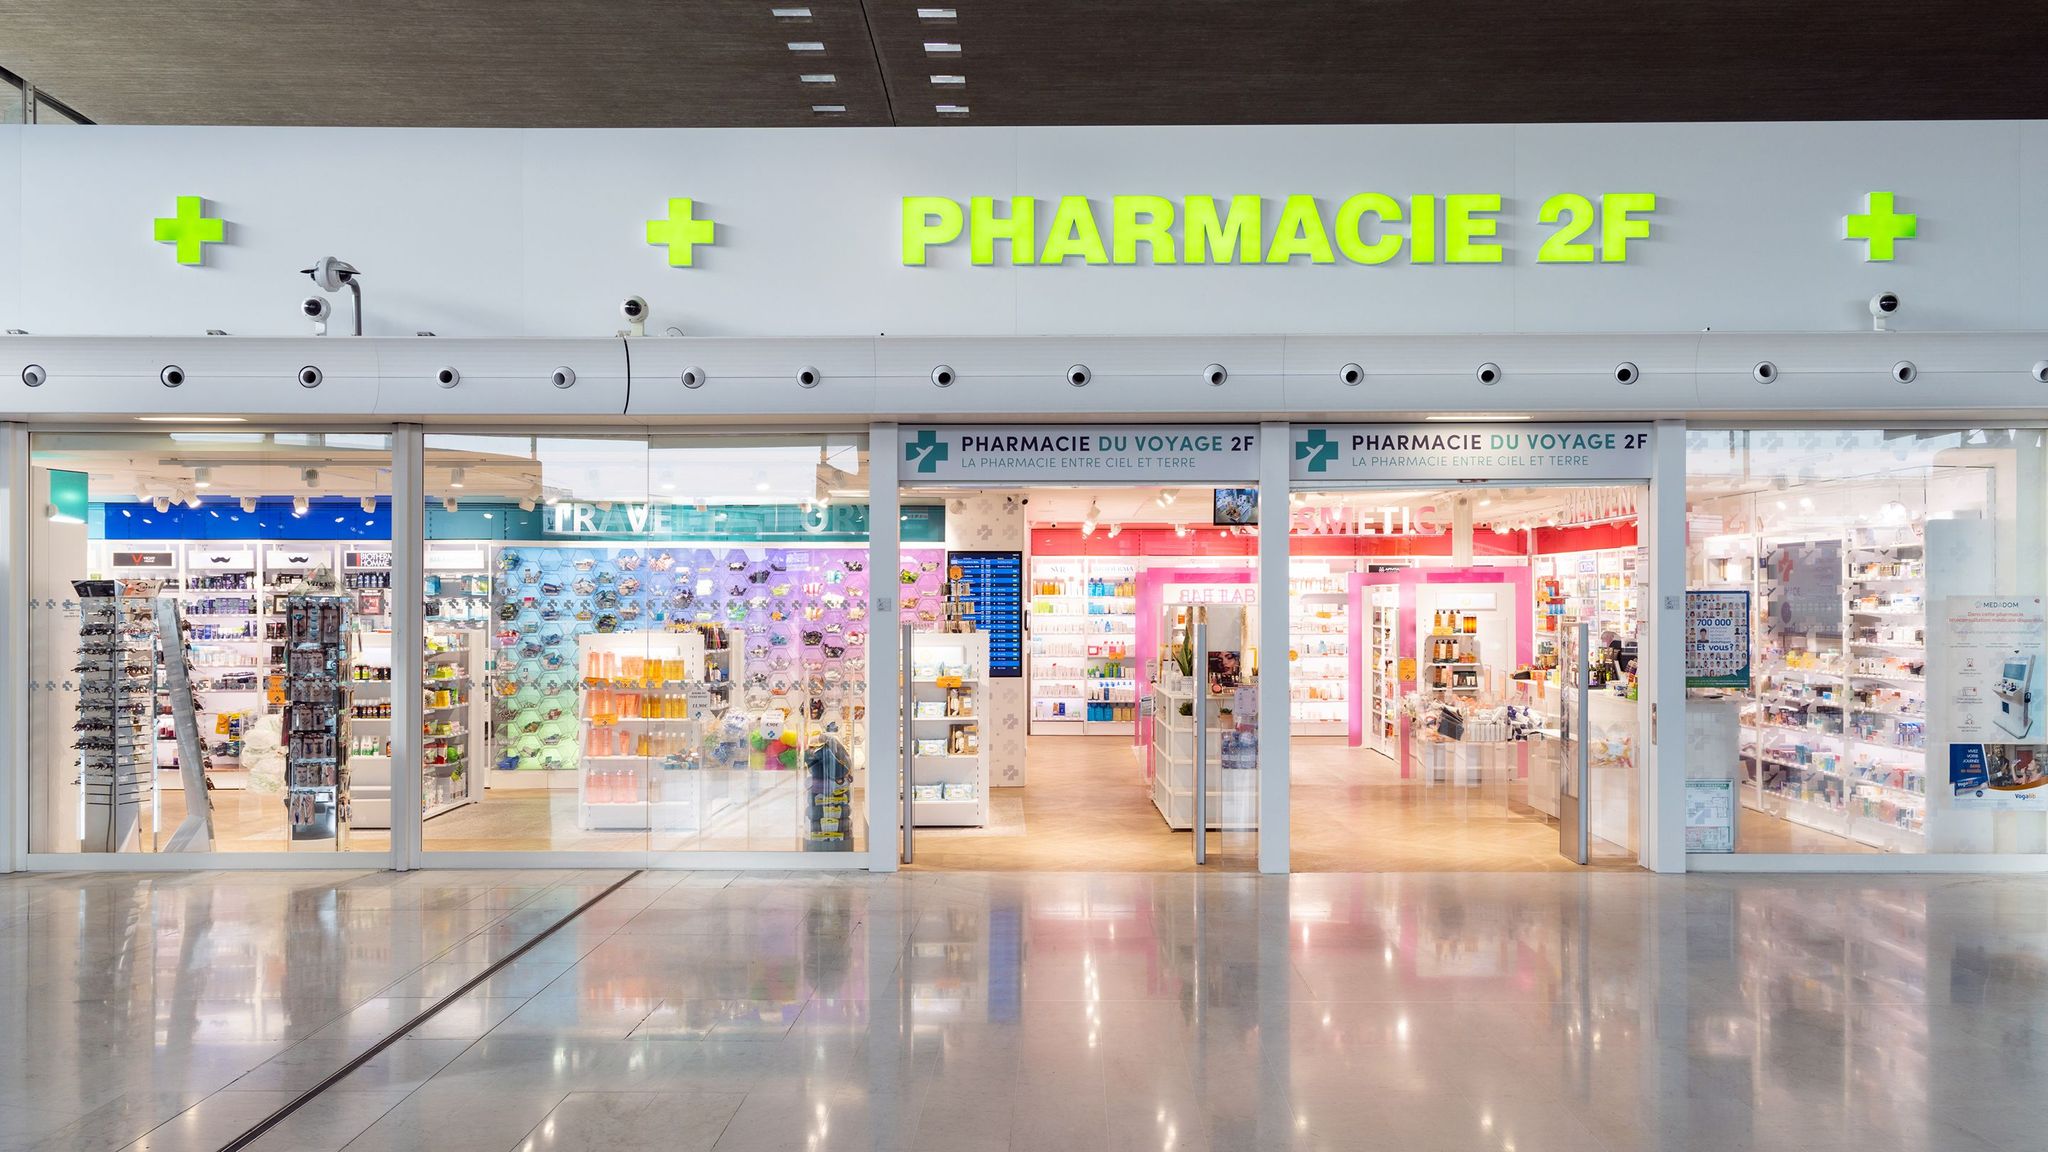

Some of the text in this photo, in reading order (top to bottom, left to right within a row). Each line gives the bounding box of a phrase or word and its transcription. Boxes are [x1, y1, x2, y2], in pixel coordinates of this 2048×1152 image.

[902, 193, 1656, 265] PHARMACIE 2F
[962, 436, 1255, 452] PHARMACIE DU VOYAGE 2F
[1352, 433, 1648, 451] PHARMACIE DU VOYAGE 2F
[961, 457, 1196, 468] LA PHARMACIE ENTRE CIEL ET TERRE
[1352, 455, 1589, 467] LA PHARMACIE ENTRE CIEL ET TERRE
[1562, 487, 1637, 524] BIENVEN
[1696, 618, 1713, 627] 700
[1696, 643, 1734, 651] Et vous?
